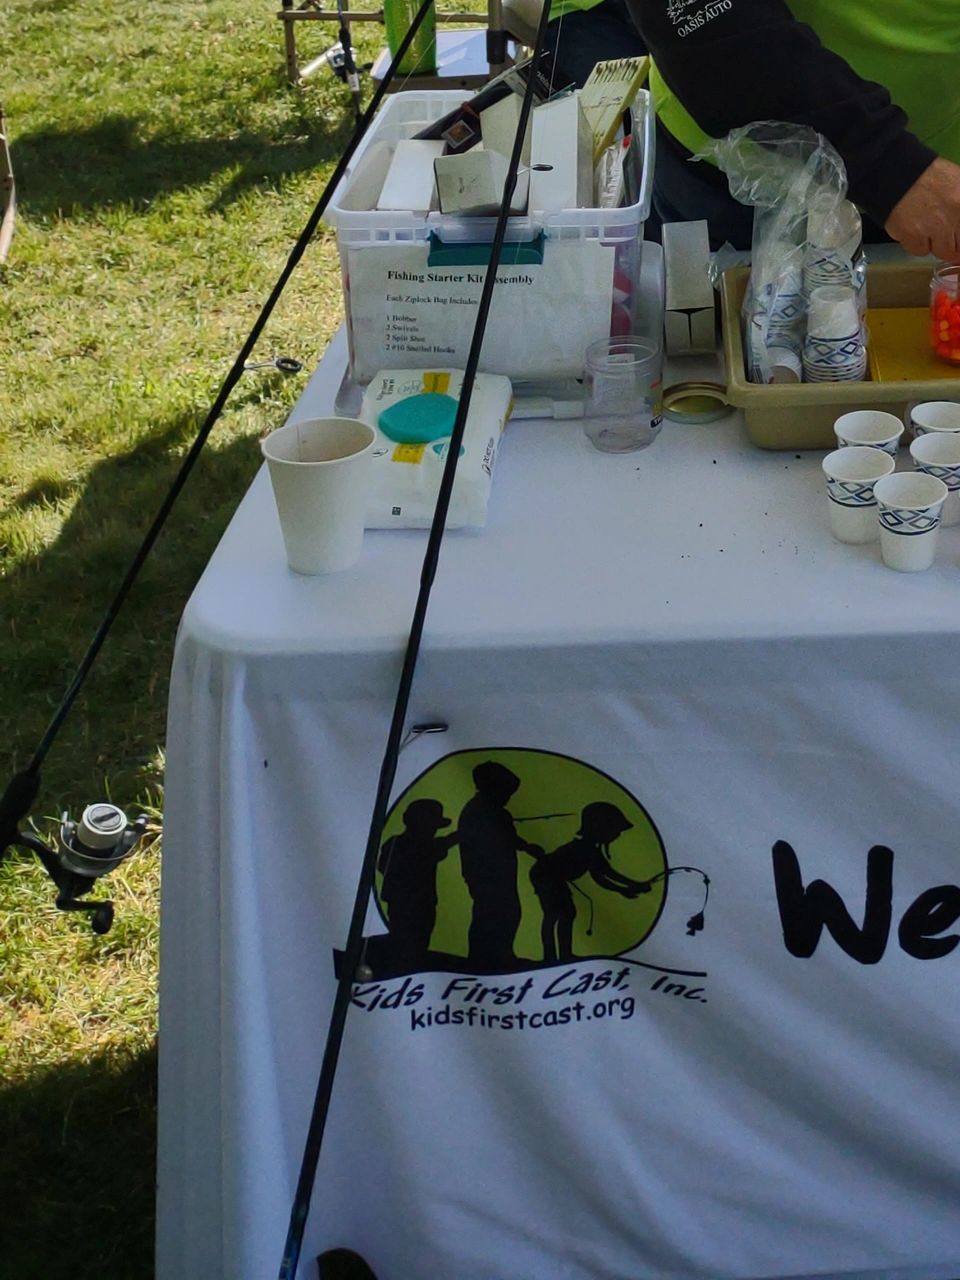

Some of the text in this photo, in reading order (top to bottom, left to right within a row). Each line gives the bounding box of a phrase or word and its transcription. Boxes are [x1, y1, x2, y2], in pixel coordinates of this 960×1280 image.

[677, 0, 732, 38] OASIS AUTO
[387, 270, 535, 285] Fishing Starter Kit ssembly
[386, 294, 403, 302] Each
[404, 295, 431, 304] Ziplock
[349, 967, 709, 1012] Kids First Cast, Inc.
[410, 995, 636, 1032] kidsfirstcast.org
